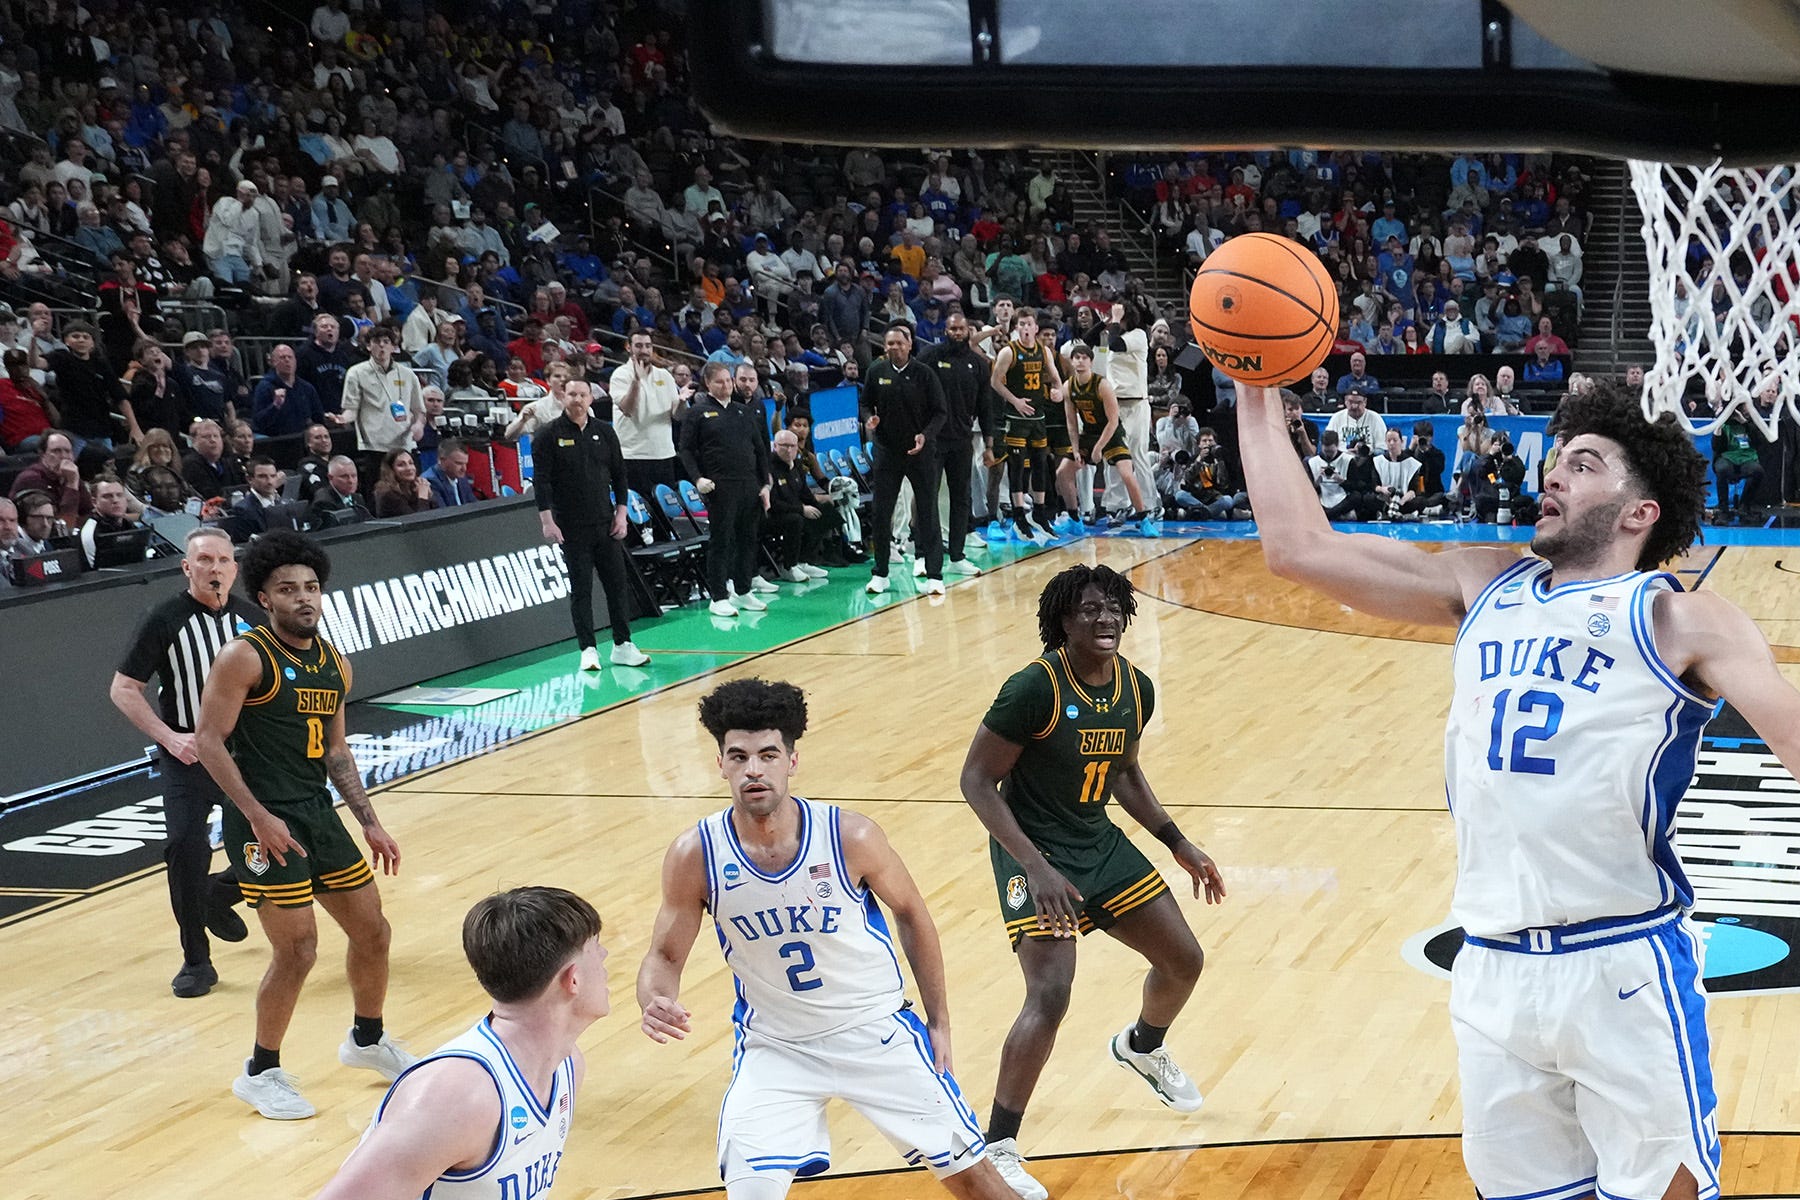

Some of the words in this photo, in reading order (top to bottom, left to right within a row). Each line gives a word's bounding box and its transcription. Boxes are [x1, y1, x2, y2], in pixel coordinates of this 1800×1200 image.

[1201, 342, 1262, 371] NCAA
[1024, 373, 1040, 390] 33
[1479, 636, 1616, 694] DUKE
[298, 690, 337, 712] SIENA
[306, 717, 325, 758] 0
[1082, 731, 1123, 753] SIENA
[1487, 689, 1565, 775] 12
[1079, 760, 1111, 802] 11
[730, 905, 841, 941] DUKE
[778, 940, 823, 992] 2
